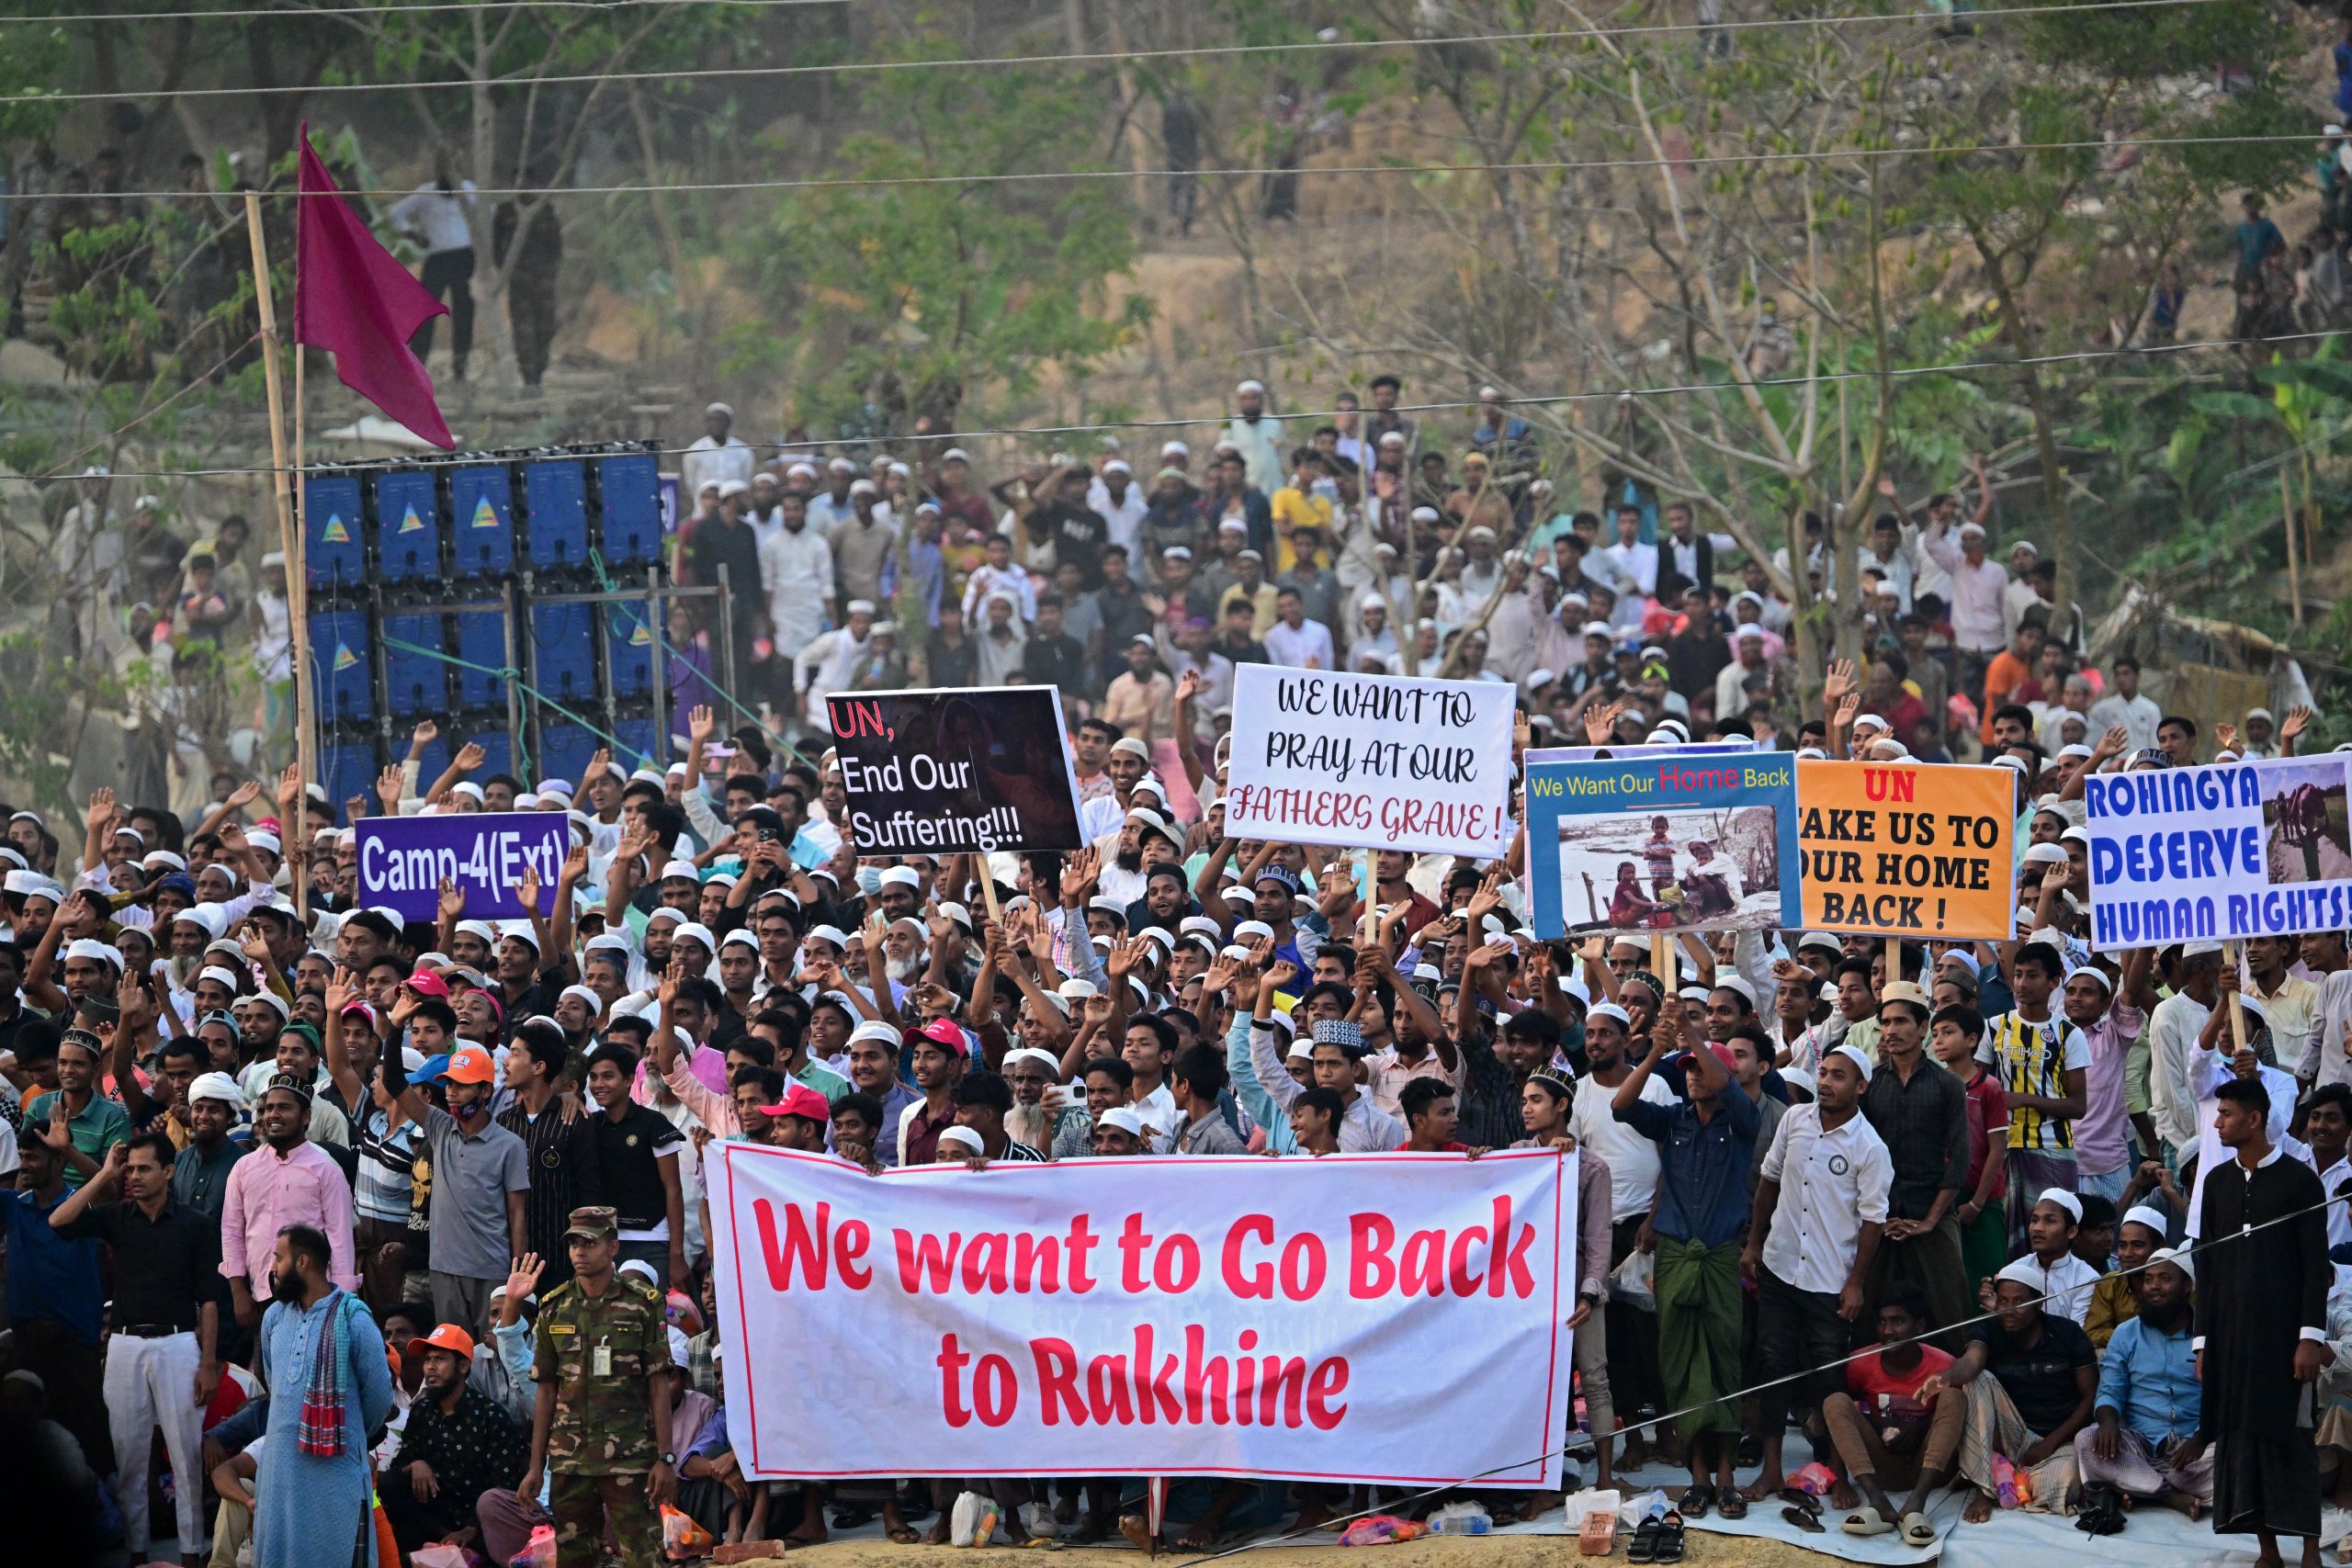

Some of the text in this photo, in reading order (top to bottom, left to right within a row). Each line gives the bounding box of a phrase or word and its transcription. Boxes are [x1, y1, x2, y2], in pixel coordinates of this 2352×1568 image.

[829, 701, 895, 742] UN,
[1278, 678, 1476, 728] WE WANT TO
[841, 753, 970, 793] End Our
[1266, 731, 1477, 784] PRAY AT OUR
[1532, 764, 1790, 797] We Want Our Home Back
[1229, 784, 1373, 830] FATHERS
[1863, 769, 1917, 802] UN
[2086, 766, 2261, 818] ROHINGYA
[852, 806, 1023, 852] Suffering!!!
[1889, 812, 1936, 846] US
[1948, 815, 1999, 849] TO
[1875, 852, 1990, 890] HOME
[2091, 826, 2261, 886] DESERVE
[1821, 892, 1924, 929] BACK
[2096, 895, 2216, 944] HUMAN
[2002, 1046, 2052, 1060] ETIHAD
[752, 1194, 1536, 1302] We want to Go Back
[936, 1324, 1350, 1430] to Rakhine
